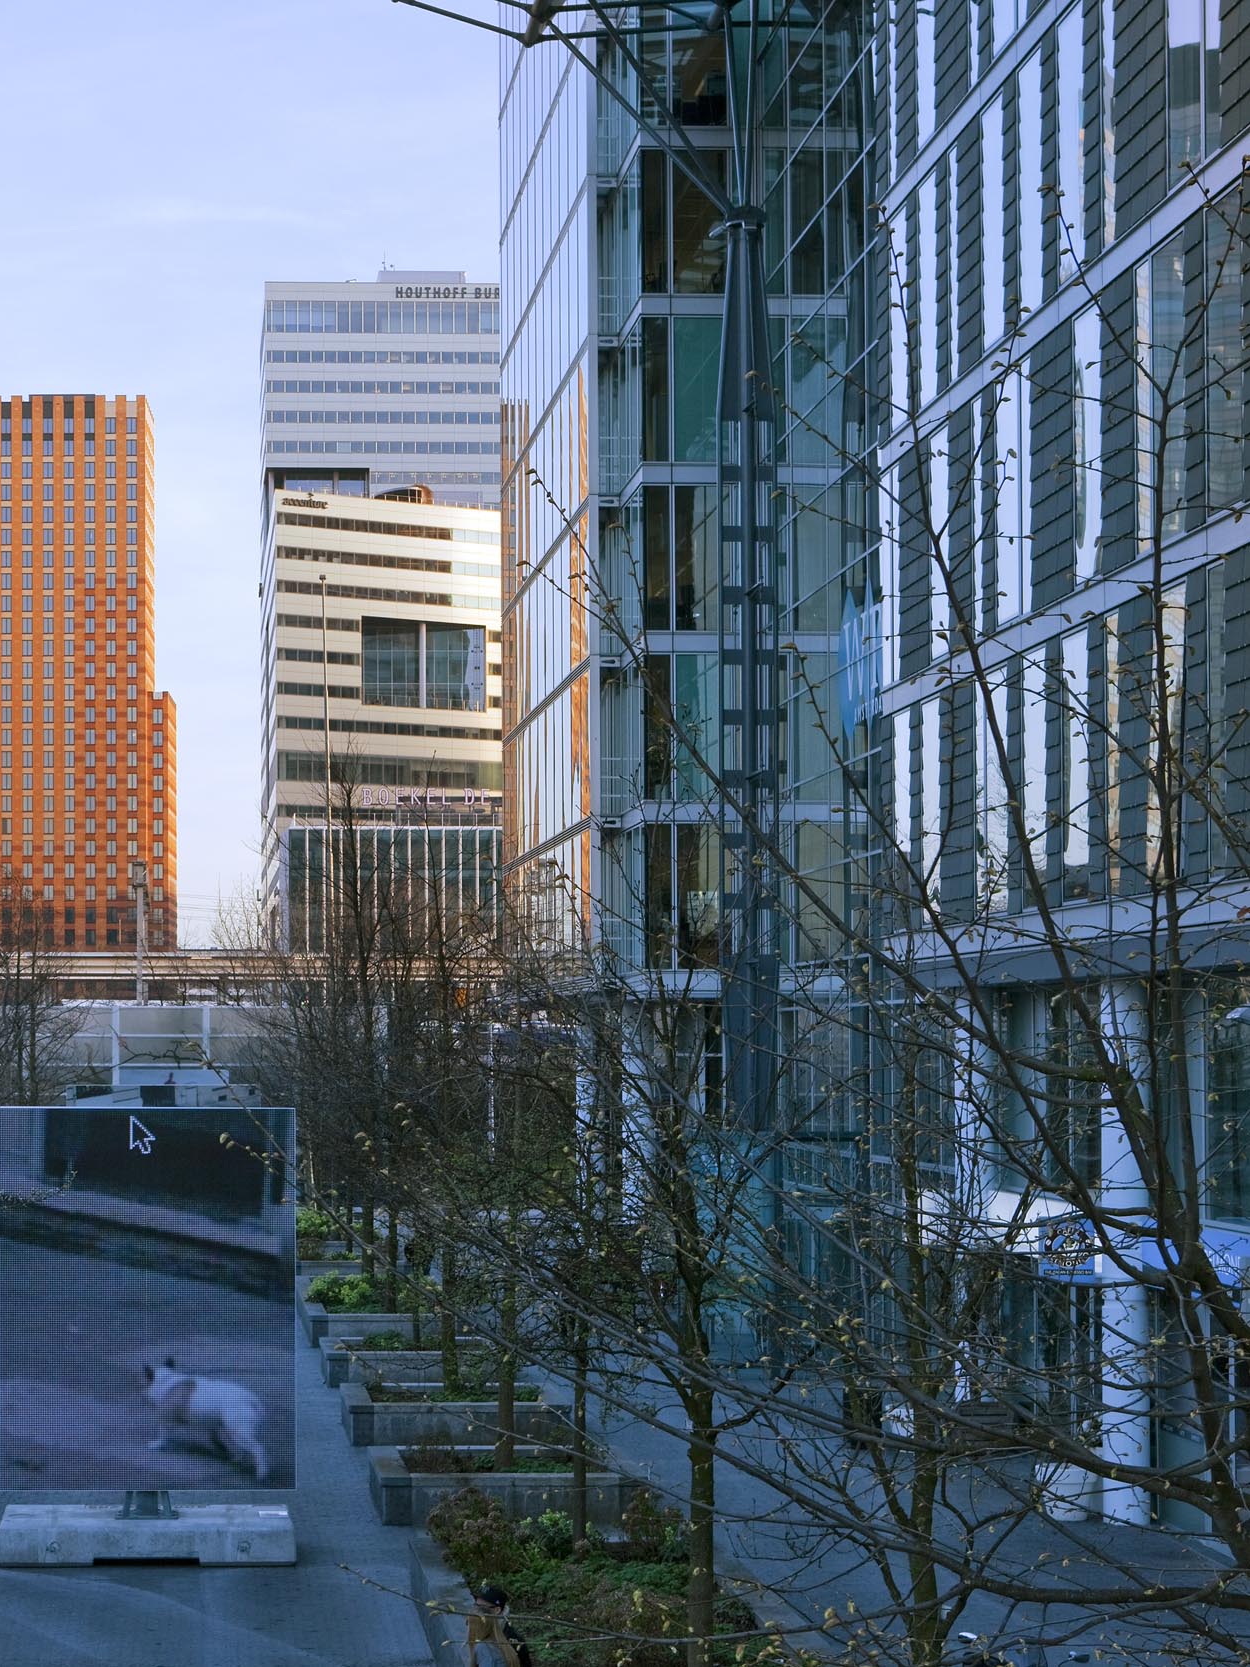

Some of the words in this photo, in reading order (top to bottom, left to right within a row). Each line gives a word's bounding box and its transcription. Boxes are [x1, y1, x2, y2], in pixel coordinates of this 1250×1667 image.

[395, 286, 467, 299] HOUTHOFF
[281, 497, 328, 510] accenture
[362, 787, 452, 806] BOEKEL
[464, 787, 491, 806] DE
